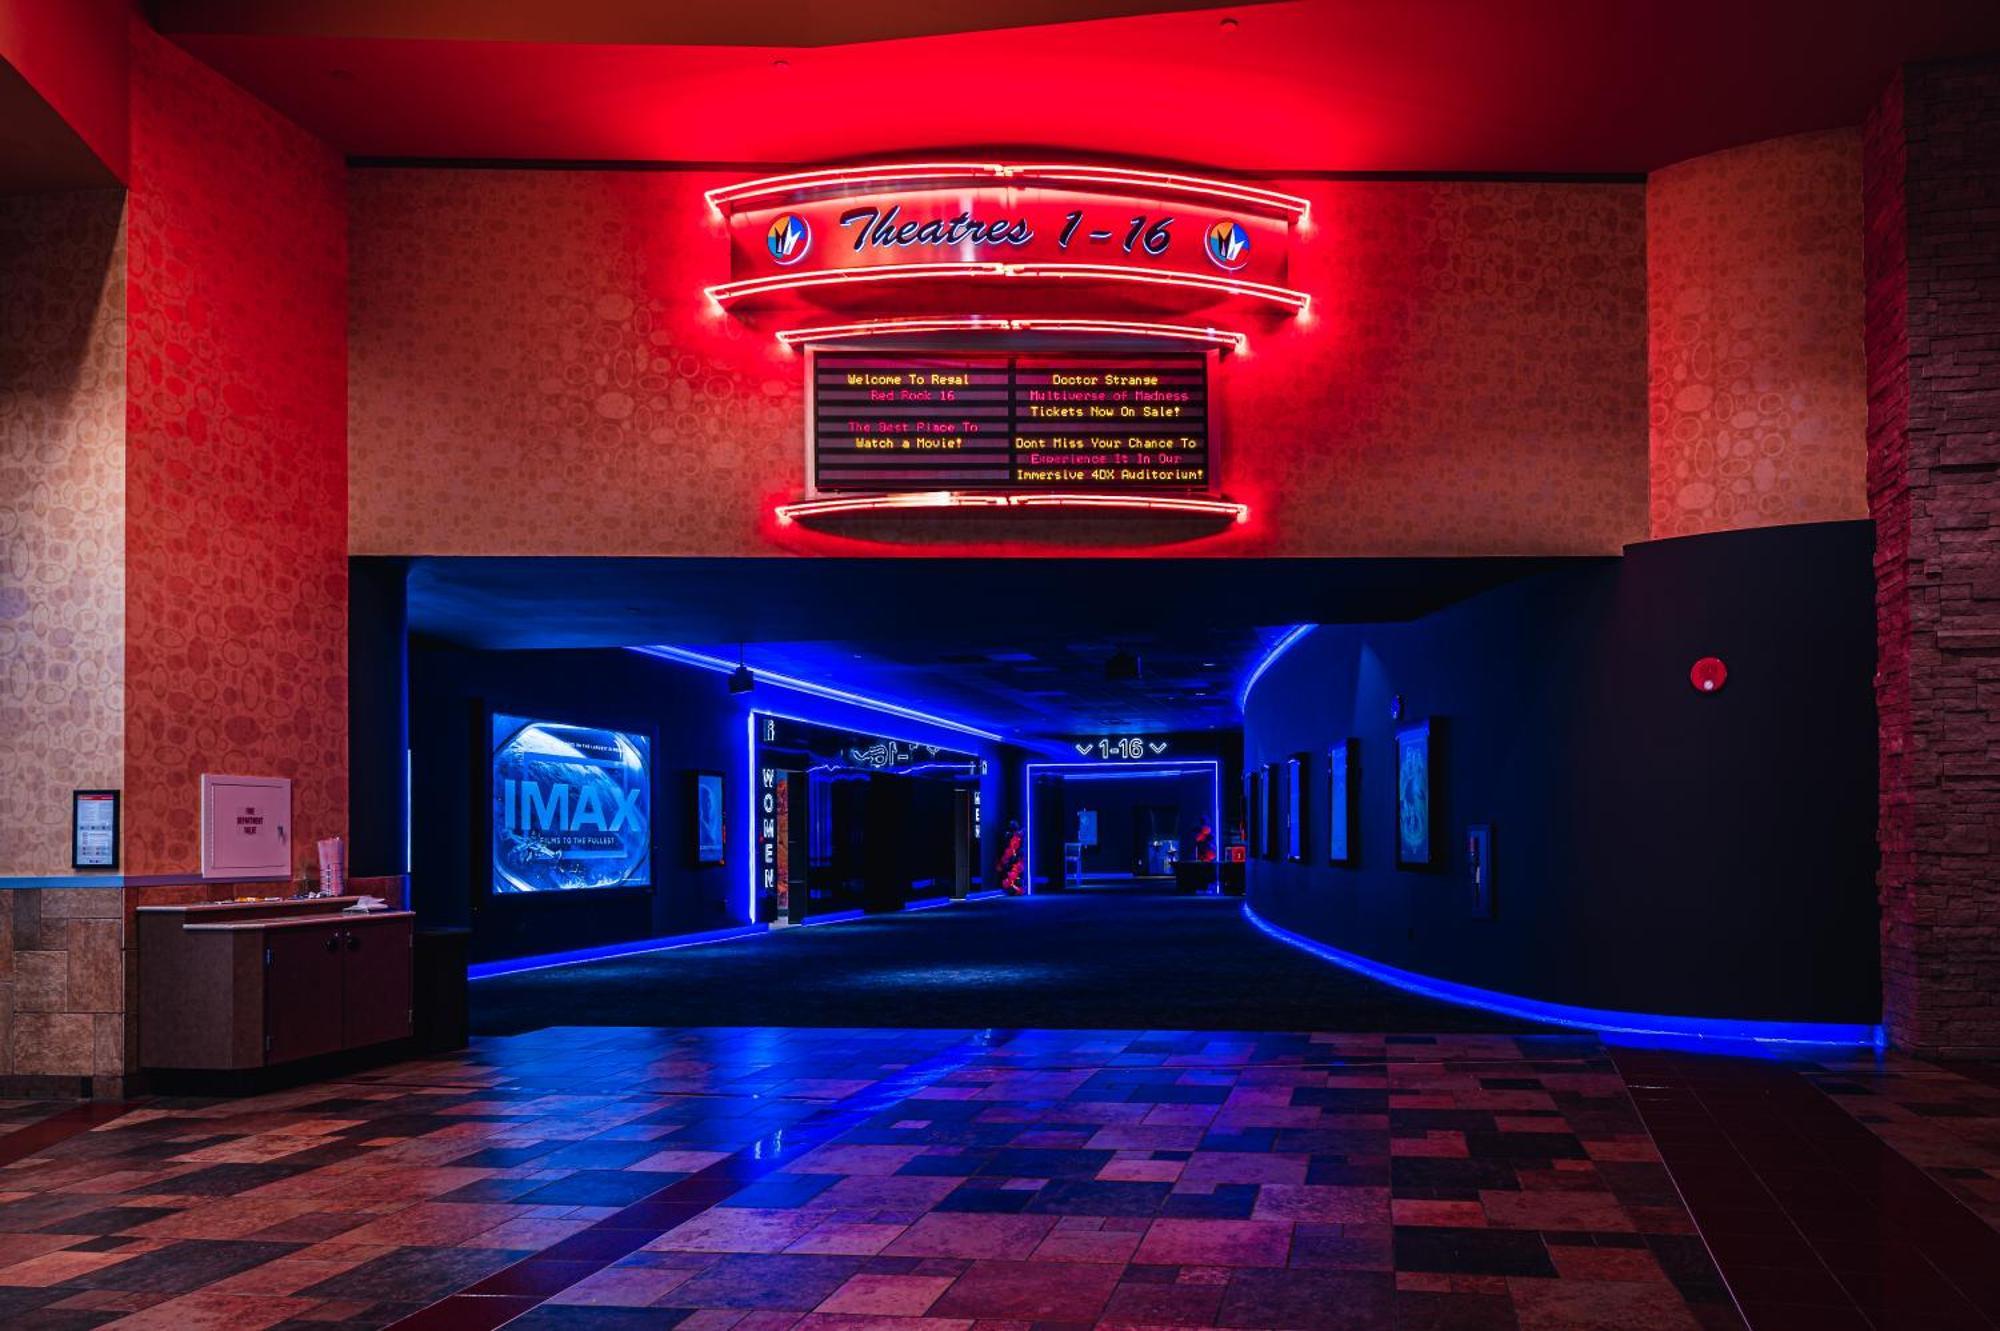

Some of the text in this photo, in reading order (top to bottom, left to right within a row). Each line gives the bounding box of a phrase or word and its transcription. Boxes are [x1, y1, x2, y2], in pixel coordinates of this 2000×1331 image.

[839, 205, 1034, 253] Theatres
[1122, 214, 1175, 255] 16
[847, 374, 901, 385] Welcome
[909, 374, 925, 385] To
[1052, 374, 1159, 386] Doctor Strange
[871, 390, 955, 401] Red Rock 16
[1030, 390, 1189, 401] Multiverse of Madness
[1030, 406, 1181, 417] Tickets Now On Sale!
[848, 422, 978, 433] The Best Place To
[856, 438, 963, 449] Watch a Movie!
[1015, 438, 1197, 449] Dont Miss Your Chance To
[1031, 454, 1182, 465] Experience It In Our
[1016, 469, 1204, 481] Immersive 4DX Auditorium!
[1098, 738, 1144, 759] 1-16
[504, 779, 641, 832] IMAX
[762, 768, 775, 888] WOMEN
[587, 836, 615, 846] FULLEST
